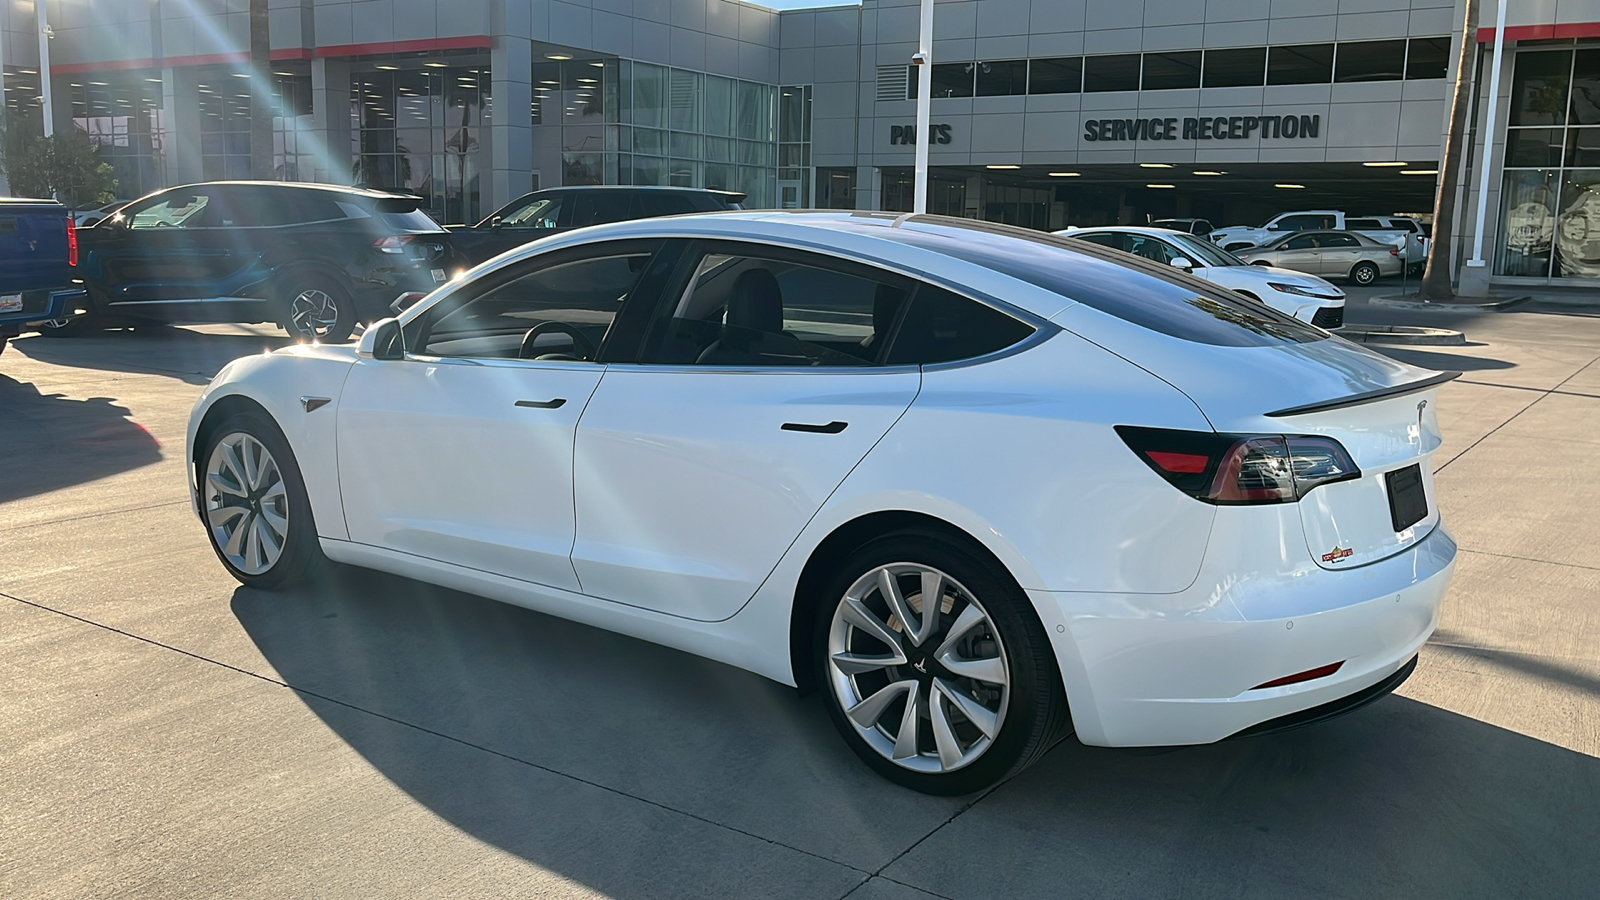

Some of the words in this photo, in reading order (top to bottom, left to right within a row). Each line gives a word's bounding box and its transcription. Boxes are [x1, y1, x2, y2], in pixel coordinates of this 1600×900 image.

[890, 123, 952, 145] PATS
[1084, 117, 1178, 141] SERVICE
[1182, 115, 1320, 140] RECEPTION
